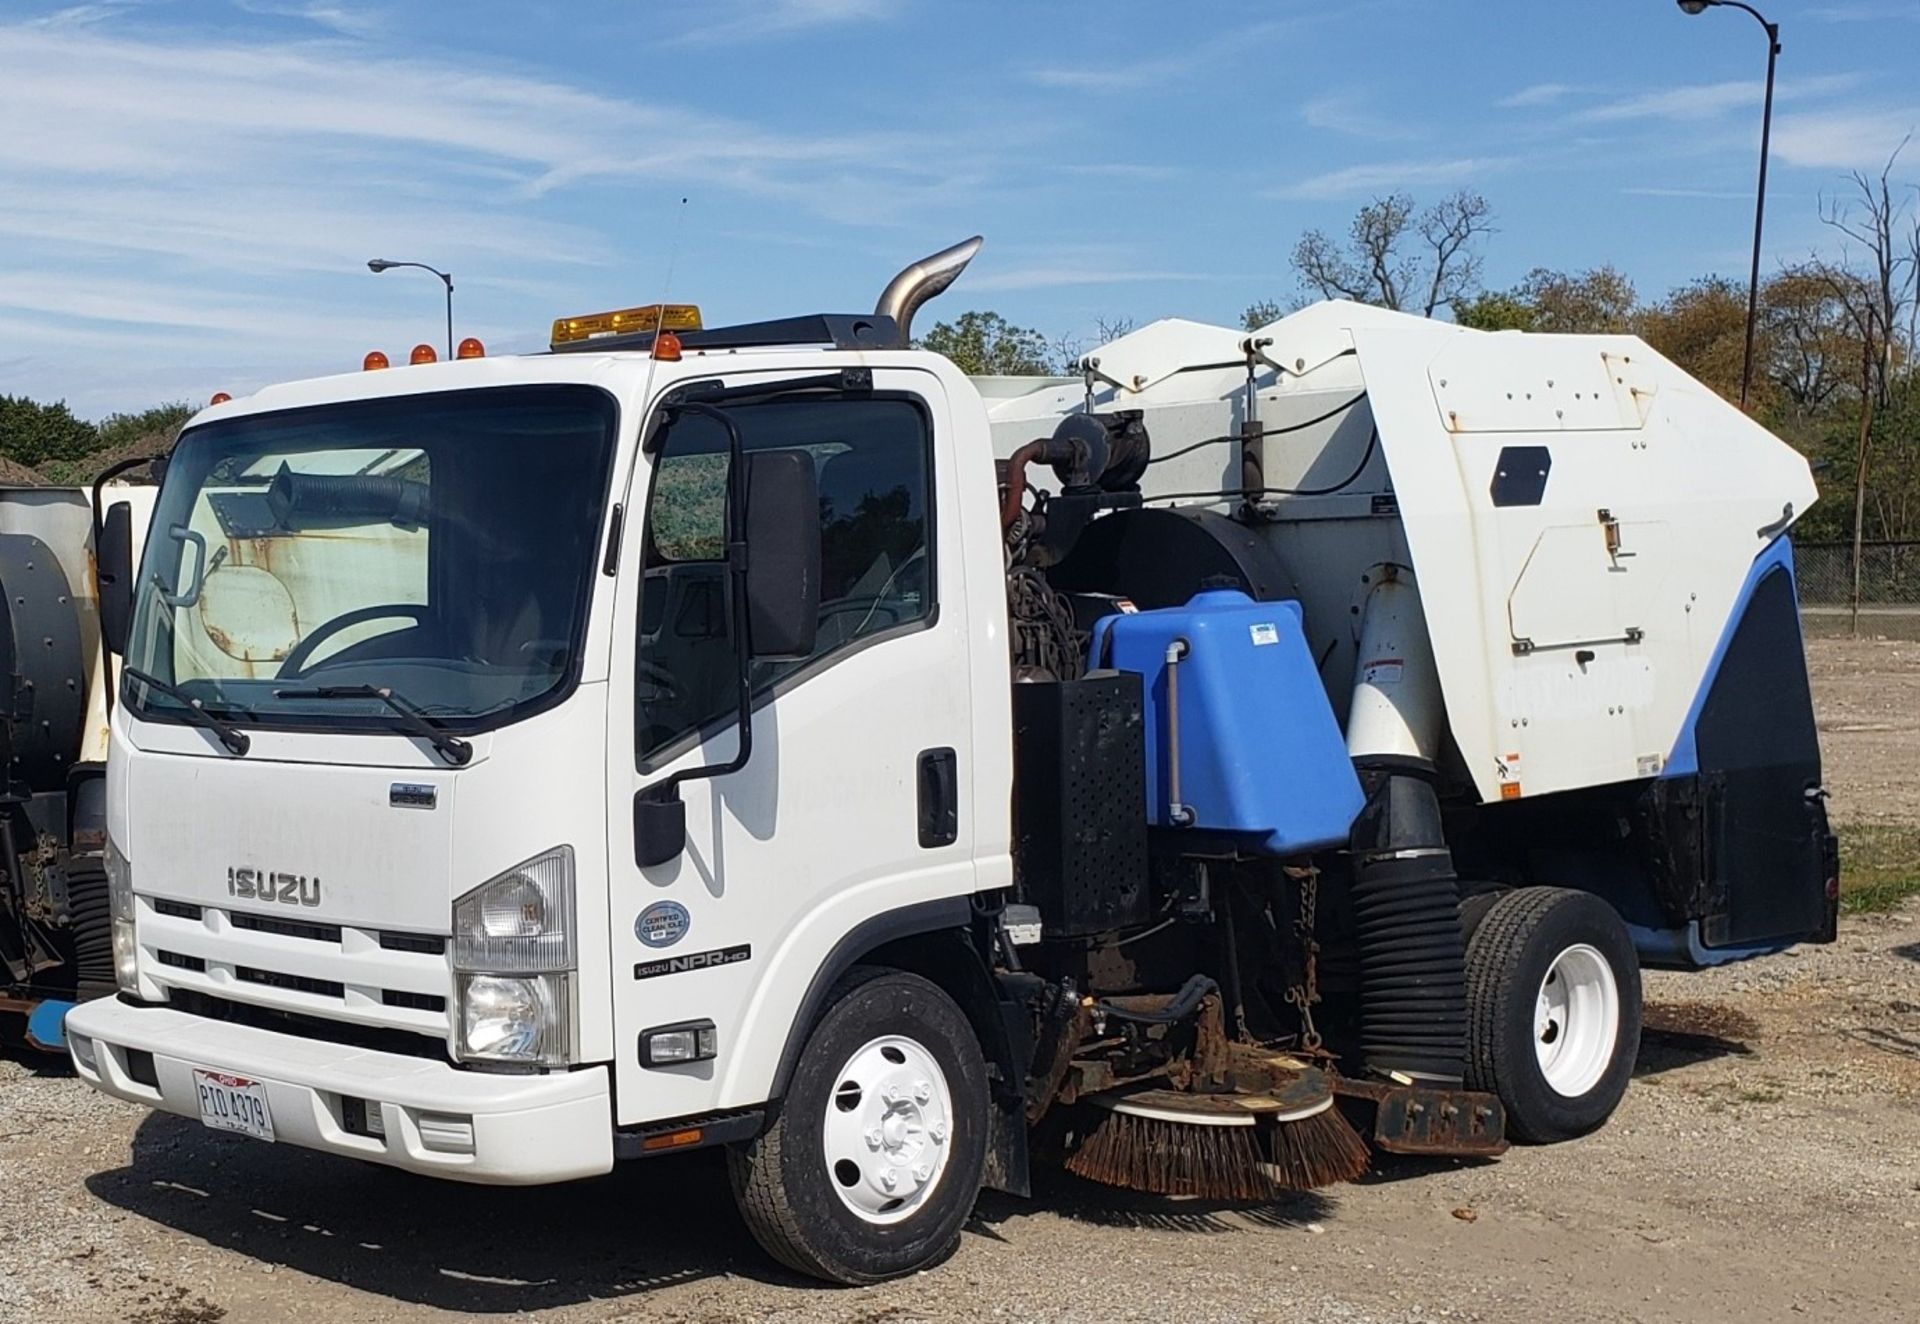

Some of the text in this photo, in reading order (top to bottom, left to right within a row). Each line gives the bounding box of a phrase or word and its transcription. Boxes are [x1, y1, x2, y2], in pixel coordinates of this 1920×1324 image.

[228, 866, 320, 907] ISUZU
[642, 920, 683, 933] CLEAN IDLE
[645, 913, 679, 925] CERTIFIED
[638, 963, 669, 976] ISUZU
[669, 951, 724, 972] NPR
[219, 1075, 237, 1087] OHIO
[230, 1091, 265, 1127] 4379
